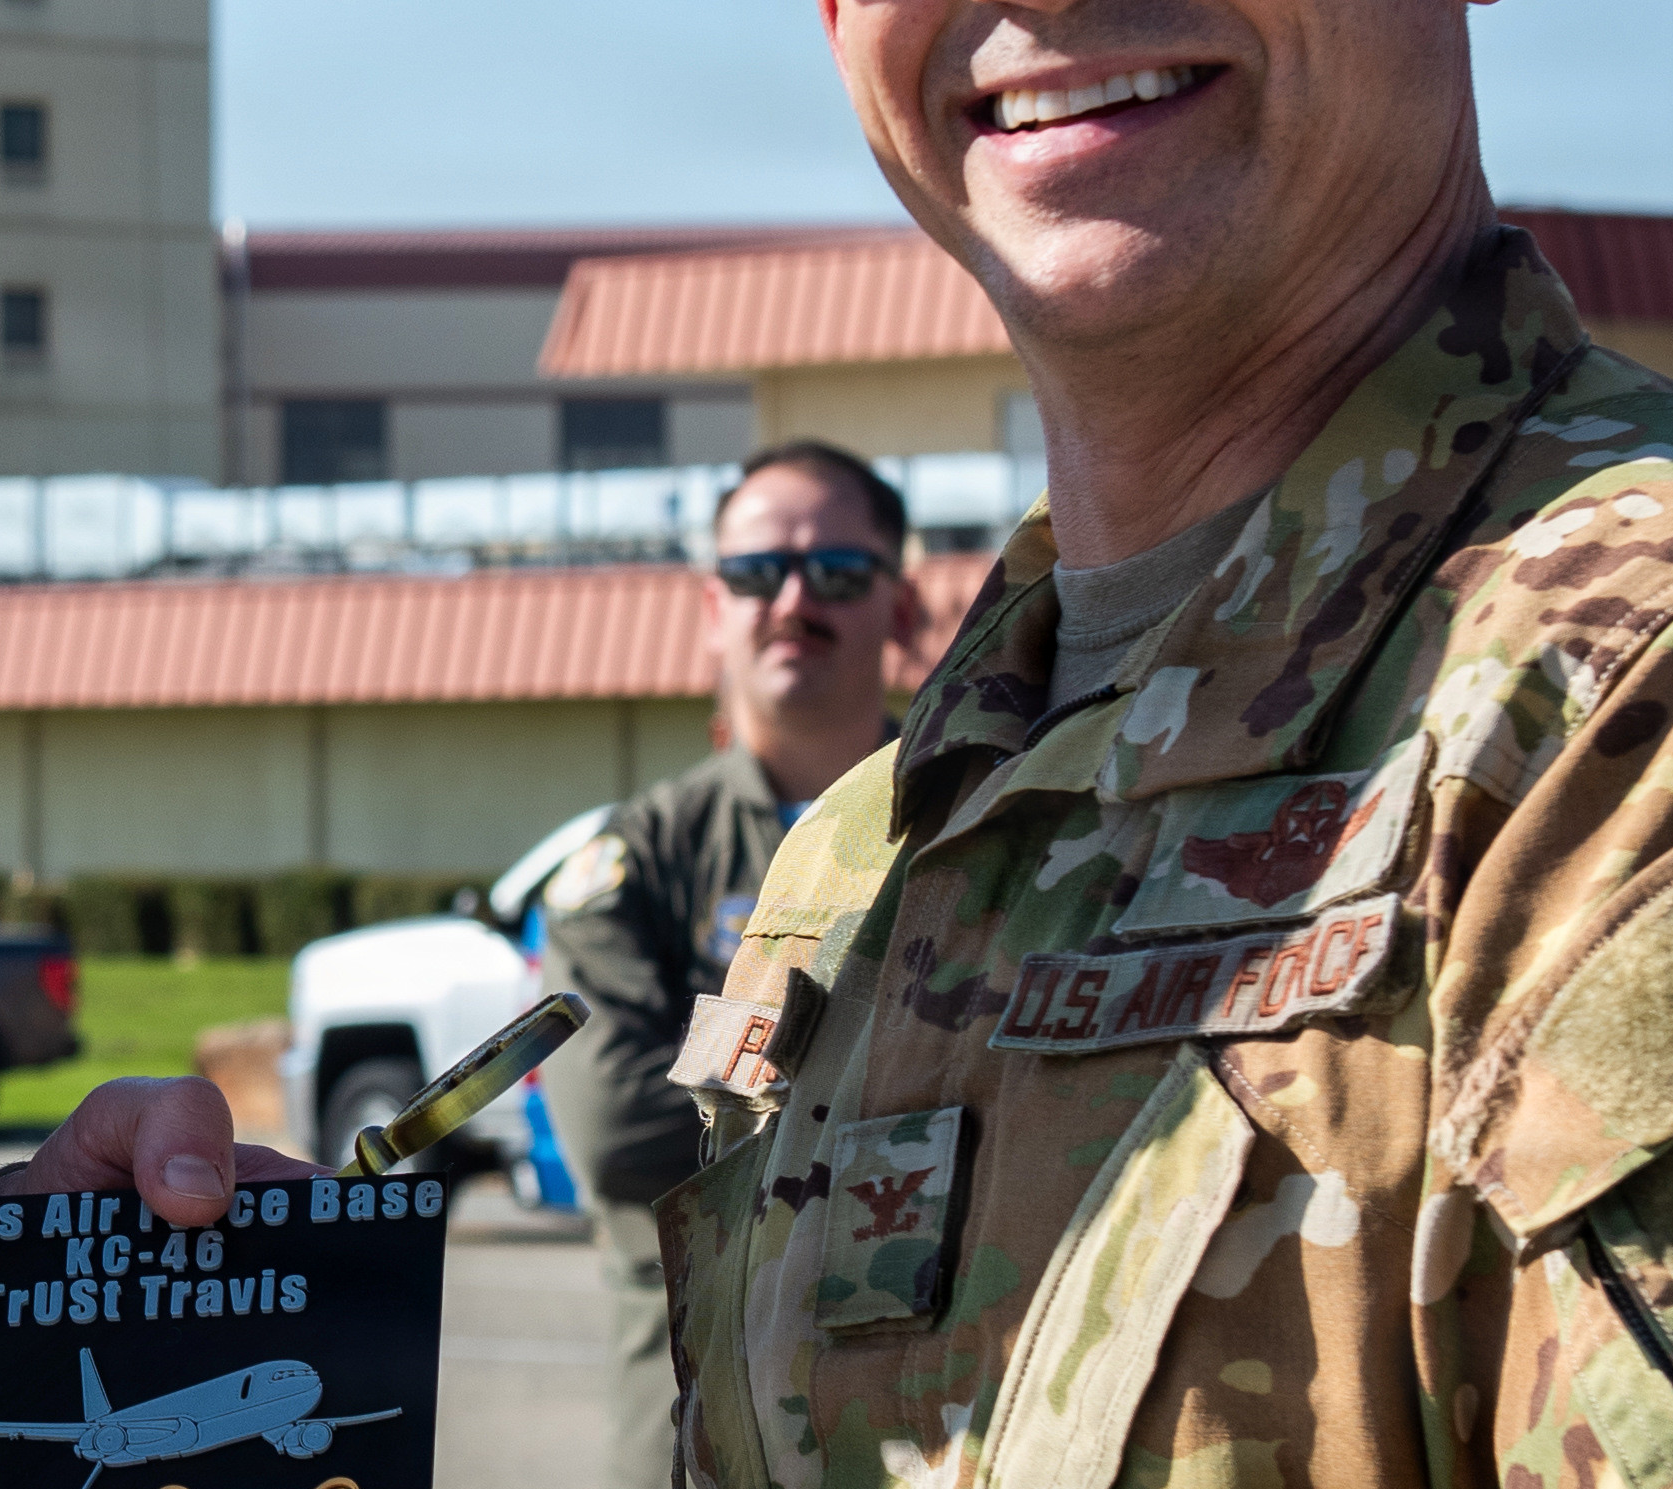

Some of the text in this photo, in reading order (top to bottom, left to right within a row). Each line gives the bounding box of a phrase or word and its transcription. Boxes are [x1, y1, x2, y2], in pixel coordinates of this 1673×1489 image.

[1003, 915, 1382, 1039] U.S. AIR FORCE
[41, 1192, 123, 1239] Air
[311, 1178, 442, 1223] Base
[64, 1231, 223, 1279] KC-46
[140, 1269, 307, 1320] Travis
